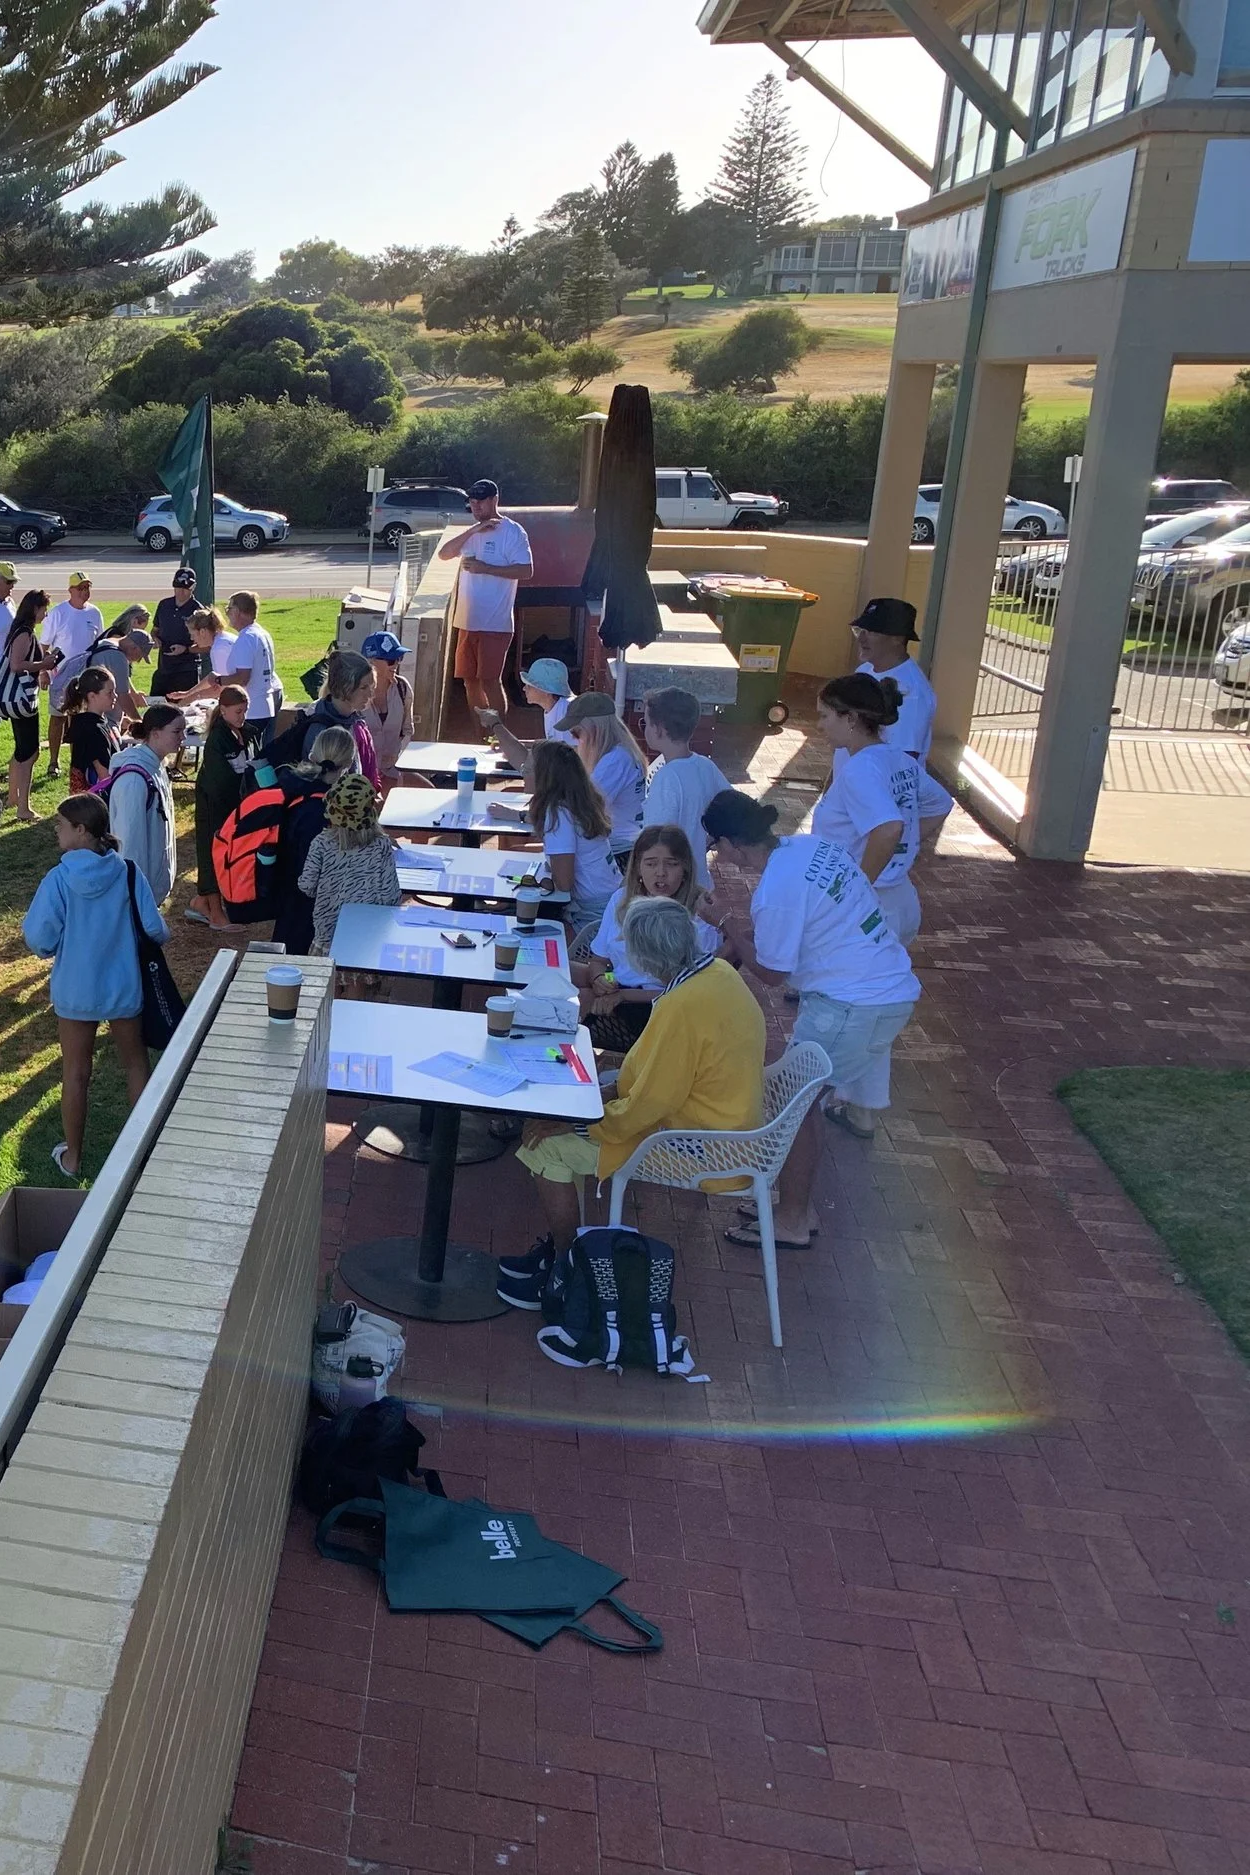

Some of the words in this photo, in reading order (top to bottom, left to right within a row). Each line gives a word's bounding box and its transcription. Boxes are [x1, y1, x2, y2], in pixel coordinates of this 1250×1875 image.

[1014, 187, 1103, 264] FORK
[1044, 253, 1087, 279] TRUCKS
[481, 1519, 517, 1560] belle
